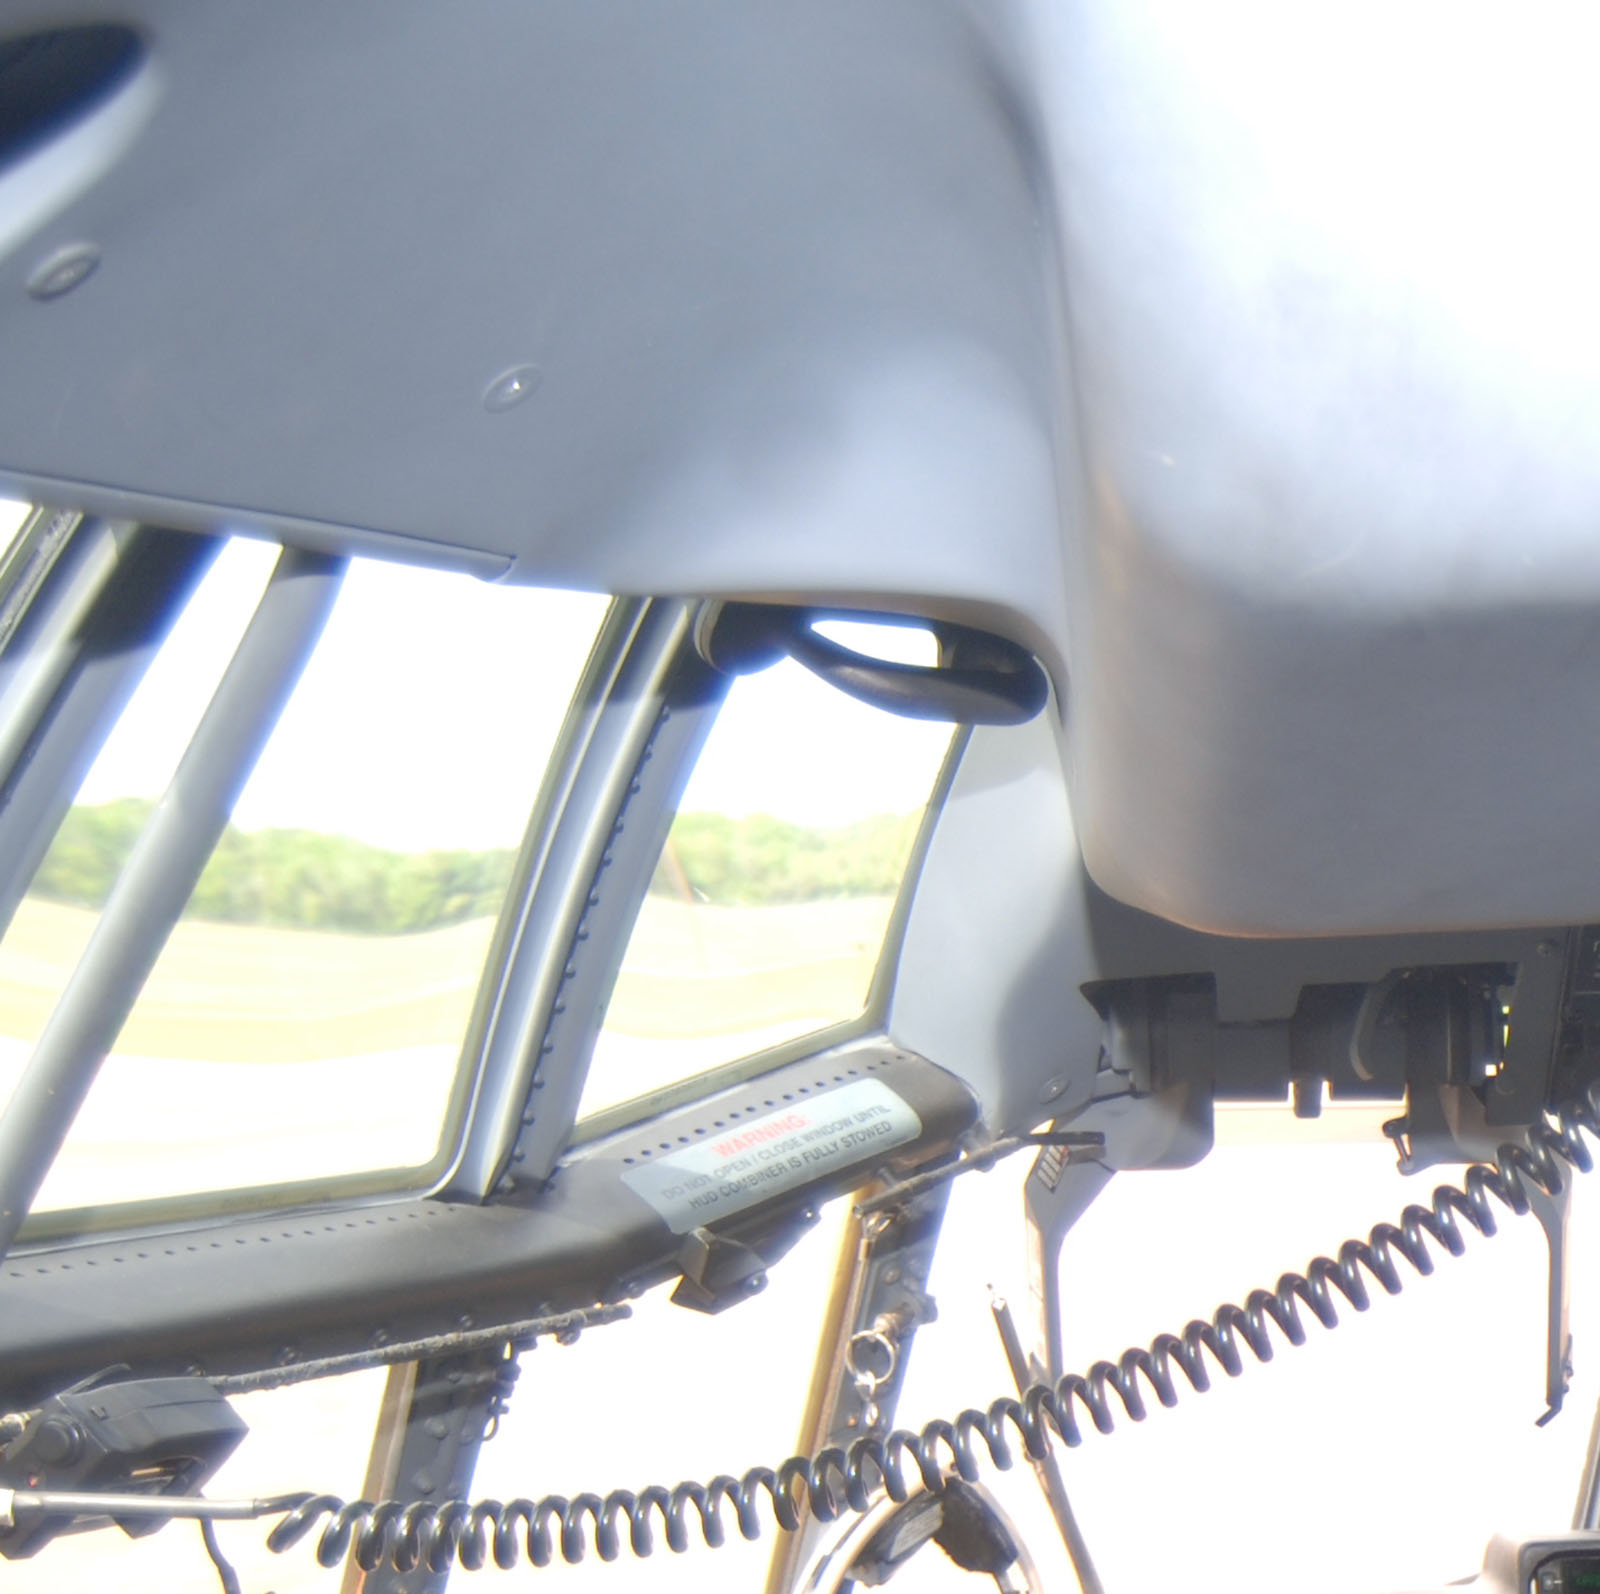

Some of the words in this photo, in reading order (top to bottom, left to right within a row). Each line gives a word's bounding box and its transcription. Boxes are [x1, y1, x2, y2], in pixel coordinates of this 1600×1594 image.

[662, 1188, 680, 1201] DO
[681, 1174, 712, 1192] NOT
[713, 1161, 751, 1179] OPEN
[757, 1139, 804, 1161] CLOSE
[799, 1118, 853, 1142] WINDOW
[853, 1104, 891, 1123] UNTIL
[688, 1191, 719, 1209] HUD
[719, 1163, 789, 1198] COMBINER
[787, 1156, 802, 1170] IS
[801, 1140, 839, 1164] FULLY
[842, 1121, 892, 1149] STOWED
